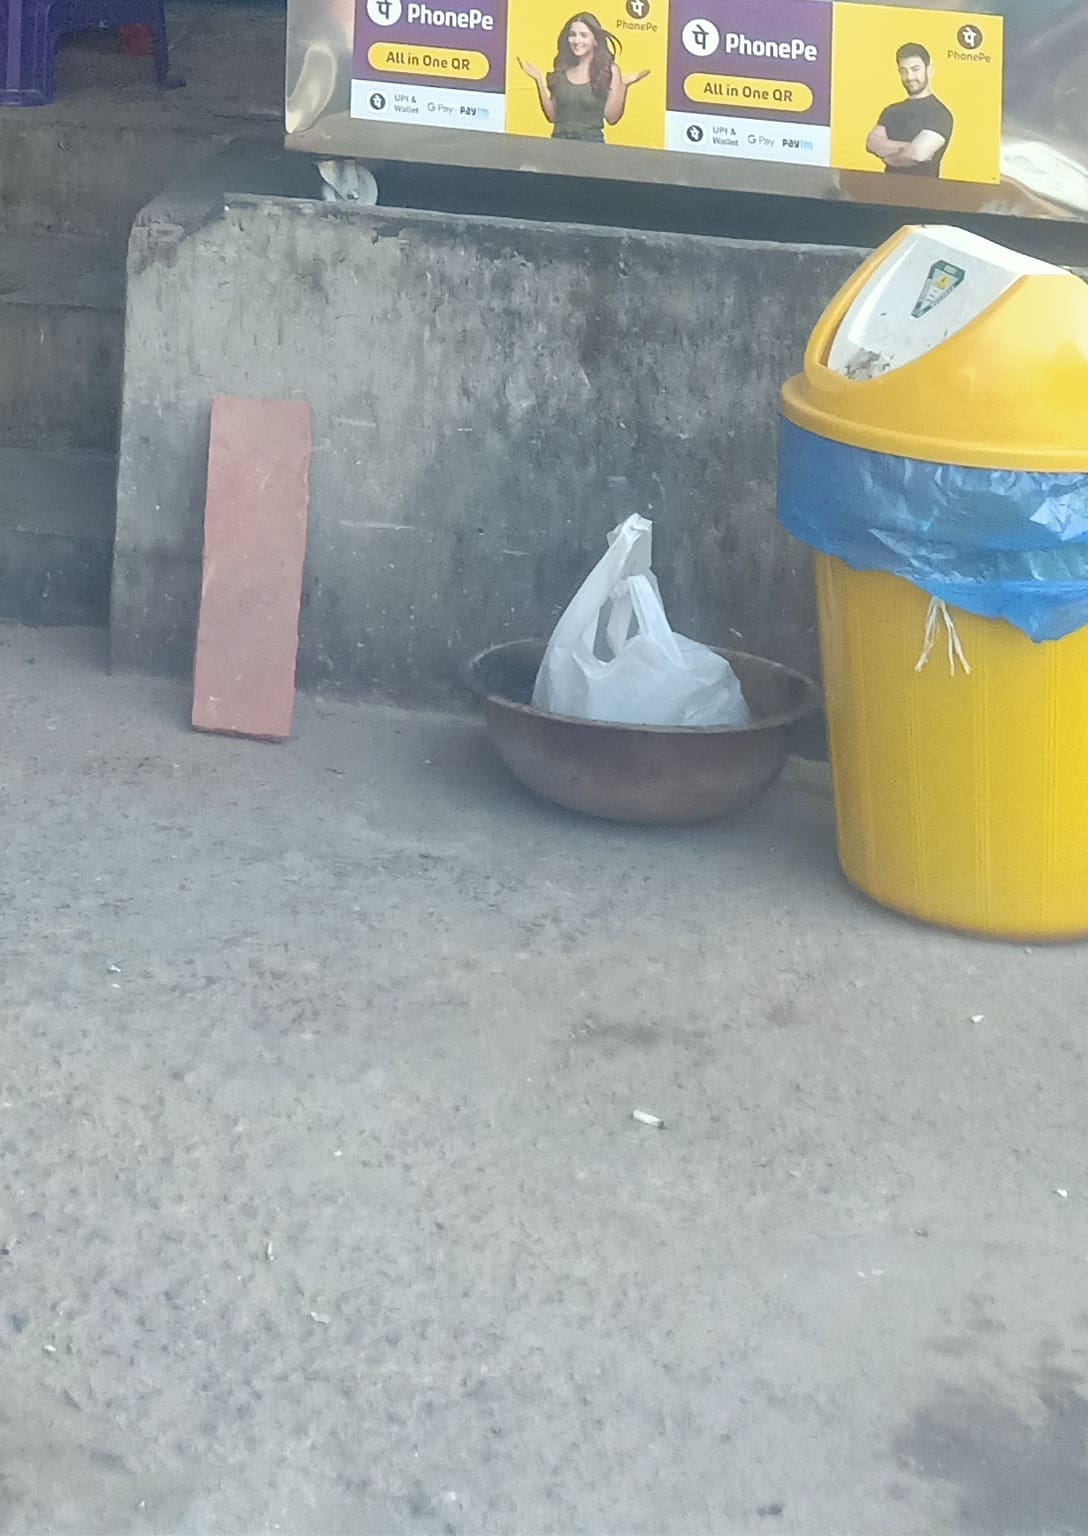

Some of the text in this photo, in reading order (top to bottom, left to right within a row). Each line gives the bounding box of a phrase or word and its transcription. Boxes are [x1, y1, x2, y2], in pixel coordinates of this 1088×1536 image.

[407, 2, 494, 31] PhonePe
[615, 19, 658, 33] PhonePe
[725, 33, 818, 61] PhonePe
[386, 51, 471, 71] All in One QR
[947, 49, 992, 63] PhonePe
[394, 93, 409, 103] UPI
[703, 81, 794, 103] All in One QR
[393, 104, 419, 115] Wallet
[437, 103, 454, 115] Pay
[712, 126, 728, 136] UPI
[712, 136, 739, 147] Wallet
[758, 135, 775, 147] Pay
